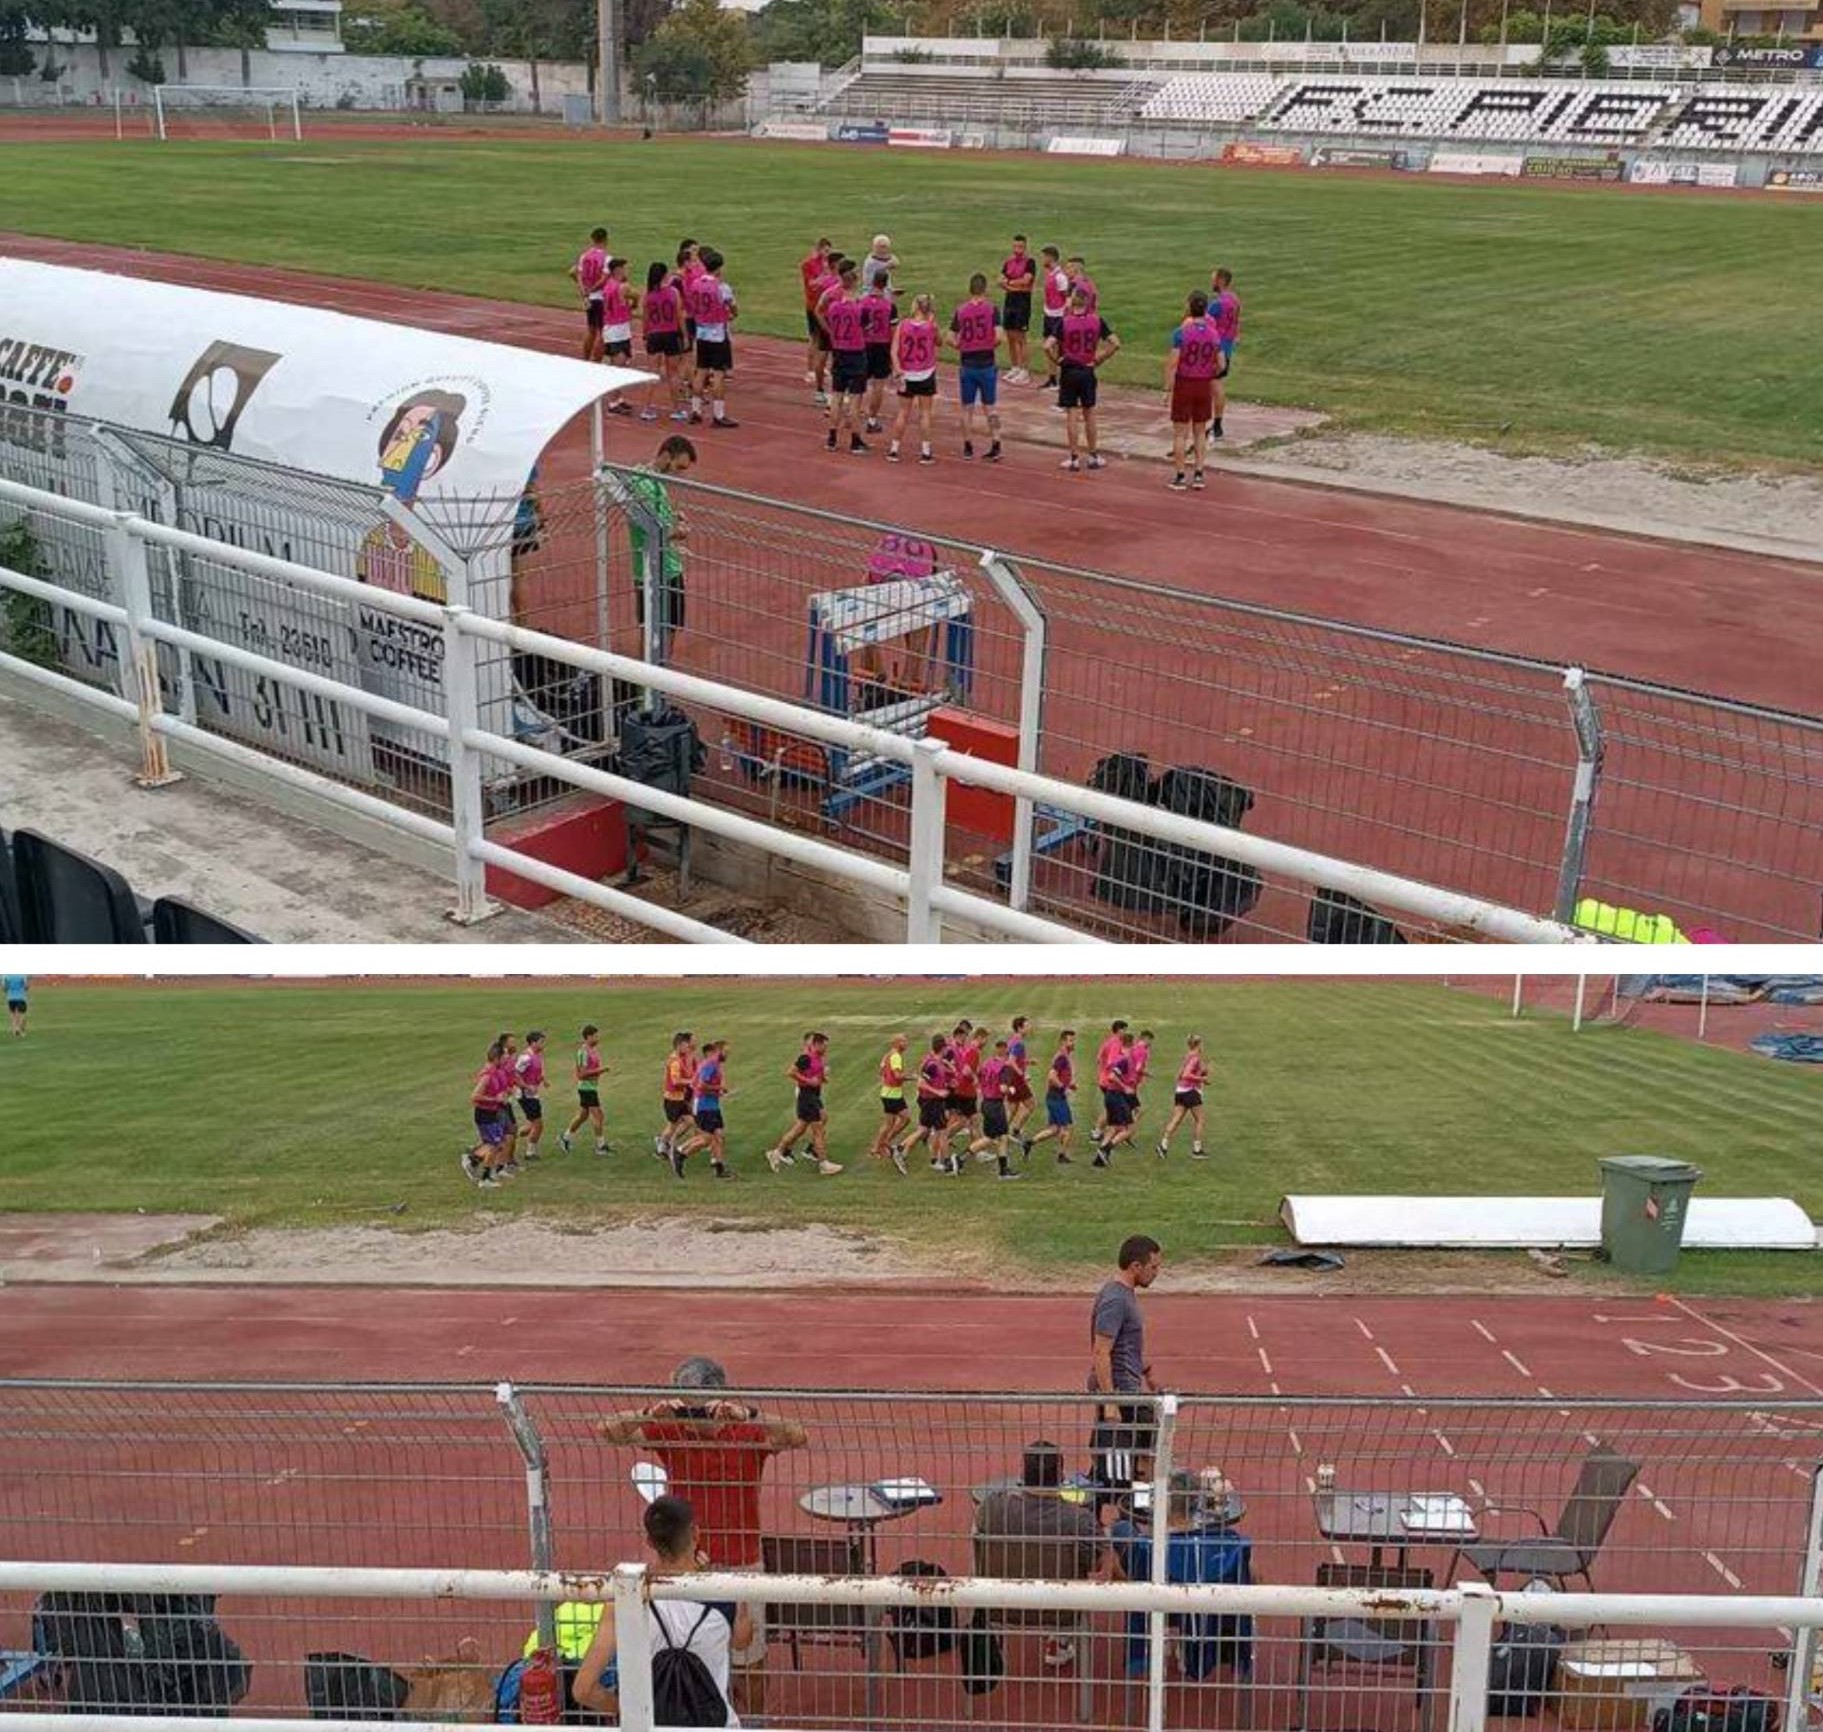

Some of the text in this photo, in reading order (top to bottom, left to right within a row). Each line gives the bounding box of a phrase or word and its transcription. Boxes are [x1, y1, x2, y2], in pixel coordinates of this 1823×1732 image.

[1736, 48, 1805, 61] METRO
[961, 314, 987, 342] 85
[903, 335, 929, 363] 25
[1184, 340, 1215, 368] 89
[359, 607, 446, 660] MAESTRO
[371, 639, 441, 684] COFFEE
[1621, 1337, 1729, 1356] 2
[1668, 1372, 1785, 1393] 3
